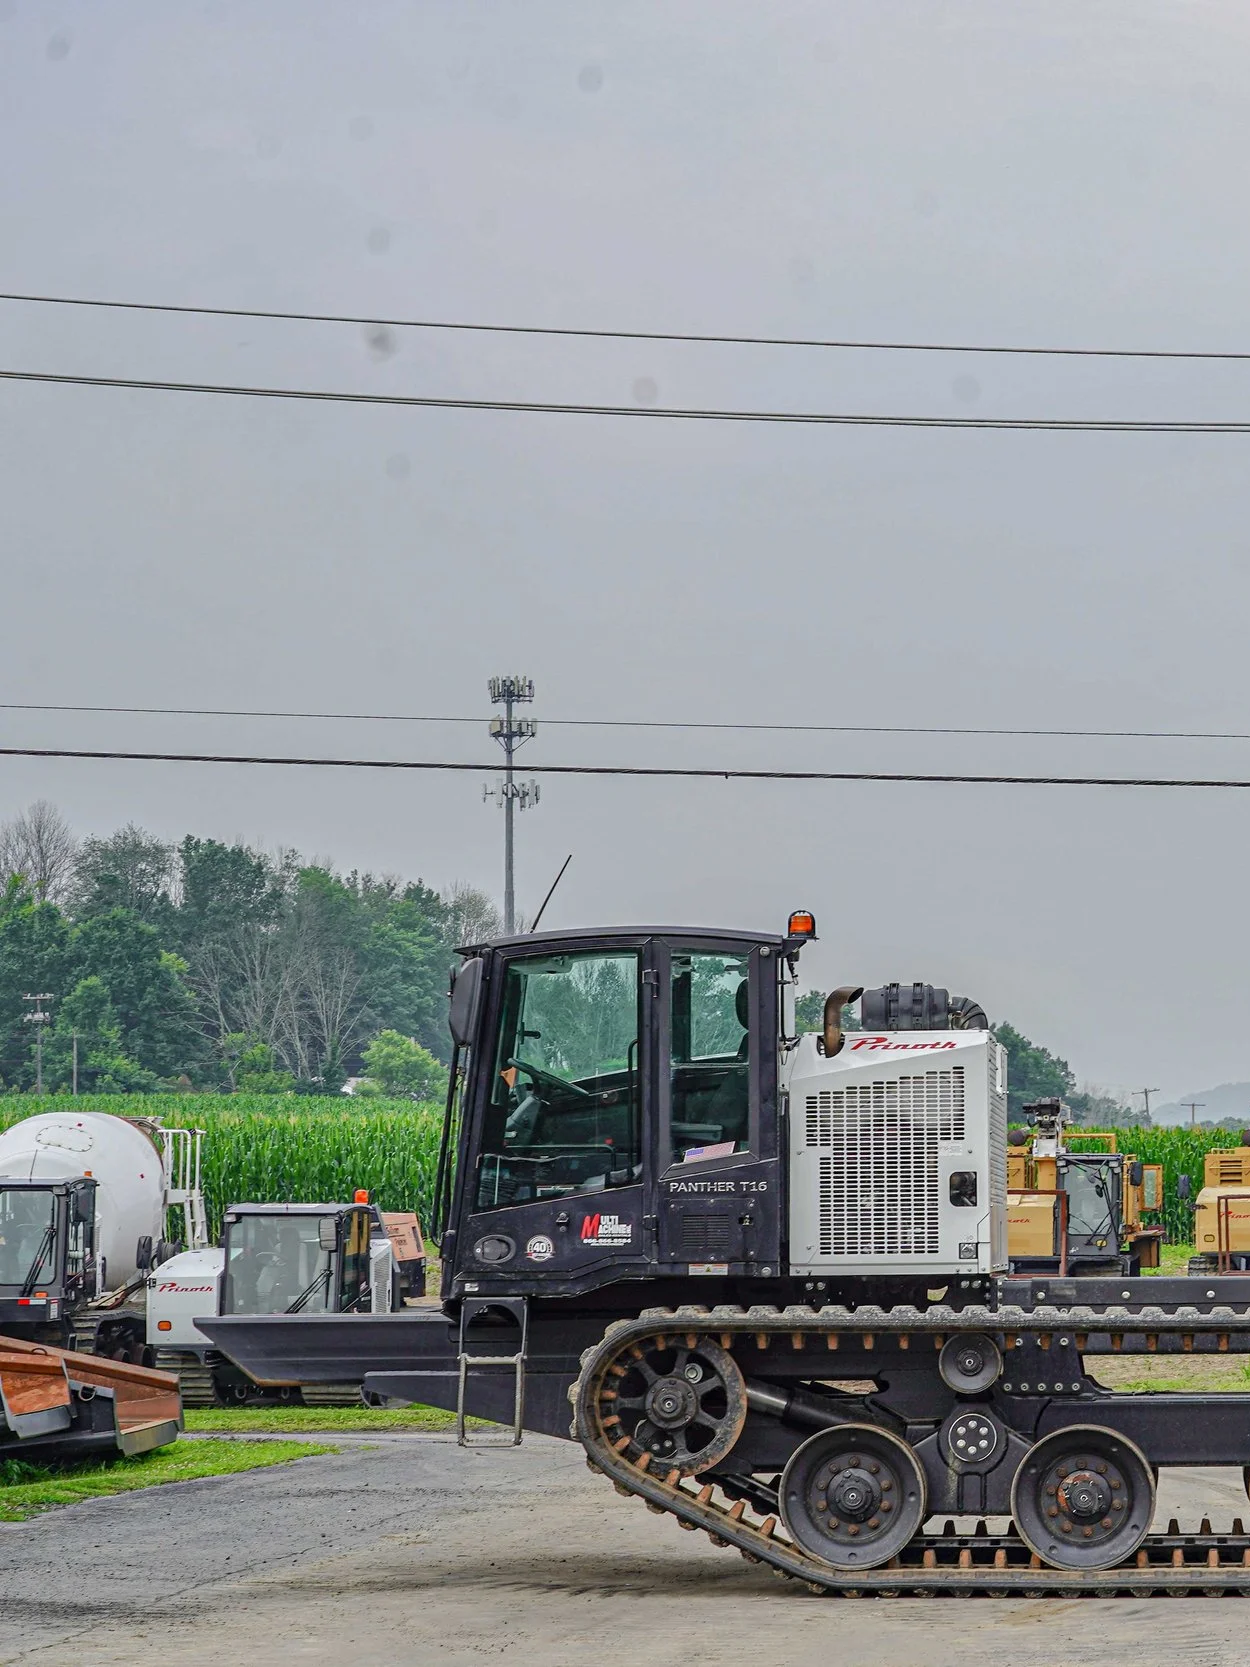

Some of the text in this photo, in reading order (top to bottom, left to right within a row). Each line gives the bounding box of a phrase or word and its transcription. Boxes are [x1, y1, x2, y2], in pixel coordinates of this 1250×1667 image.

[849, 1036, 957, 1051] Prinoth
[669, 1181, 768, 1193] PANTHER T16
[533, 1242, 547, 1253] 40
[156, 1282, 213, 1293] Prinoth
